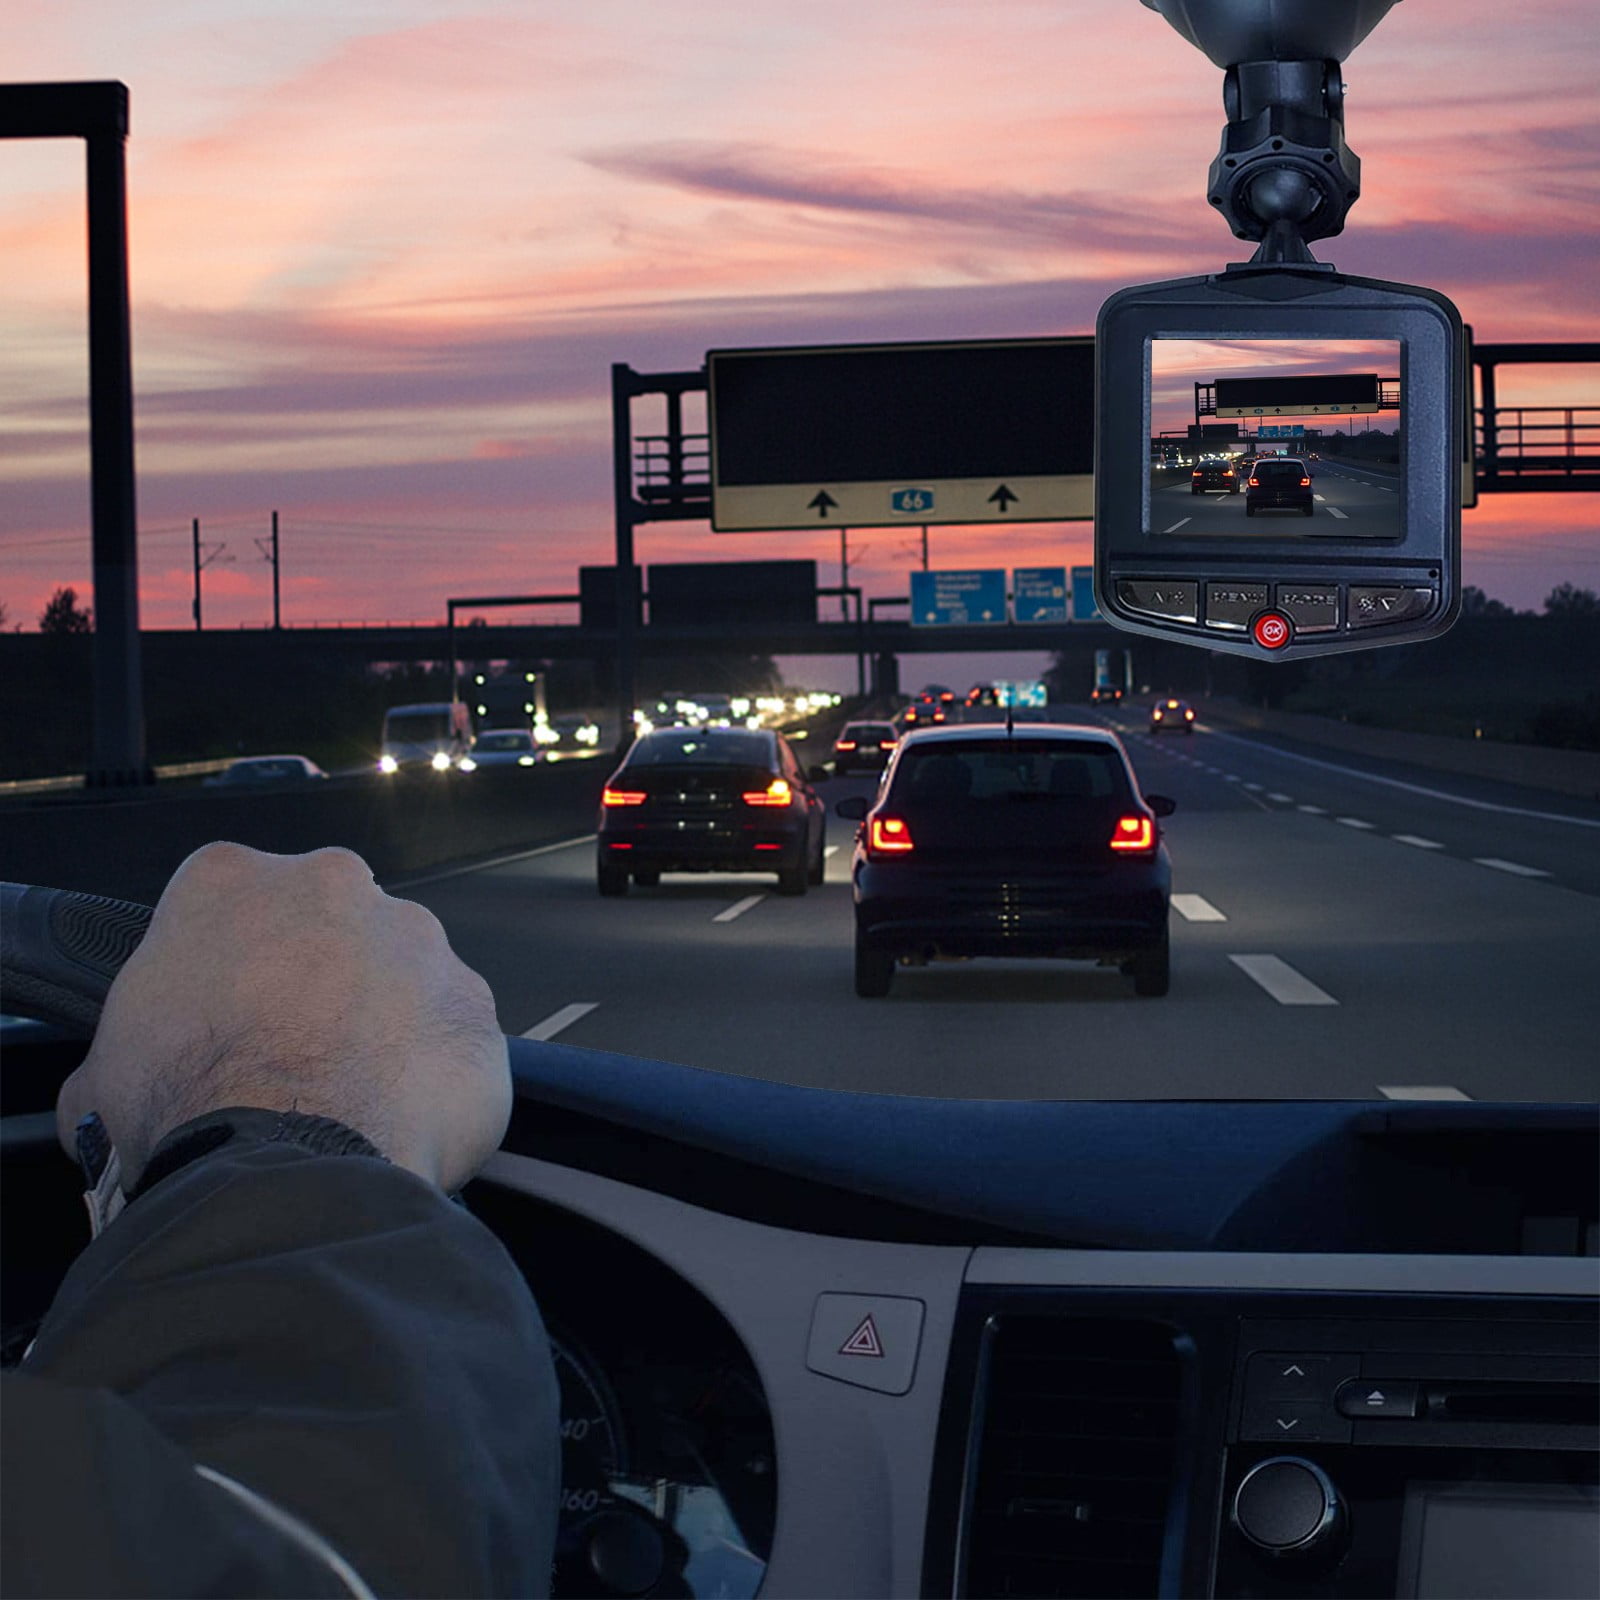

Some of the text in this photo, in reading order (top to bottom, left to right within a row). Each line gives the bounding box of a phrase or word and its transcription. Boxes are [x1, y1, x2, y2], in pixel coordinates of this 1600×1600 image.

[901, 492, 924, 509] 66
[1265, 625, 1281, 635] OK
[560, 1419, 588, 1440] 40
